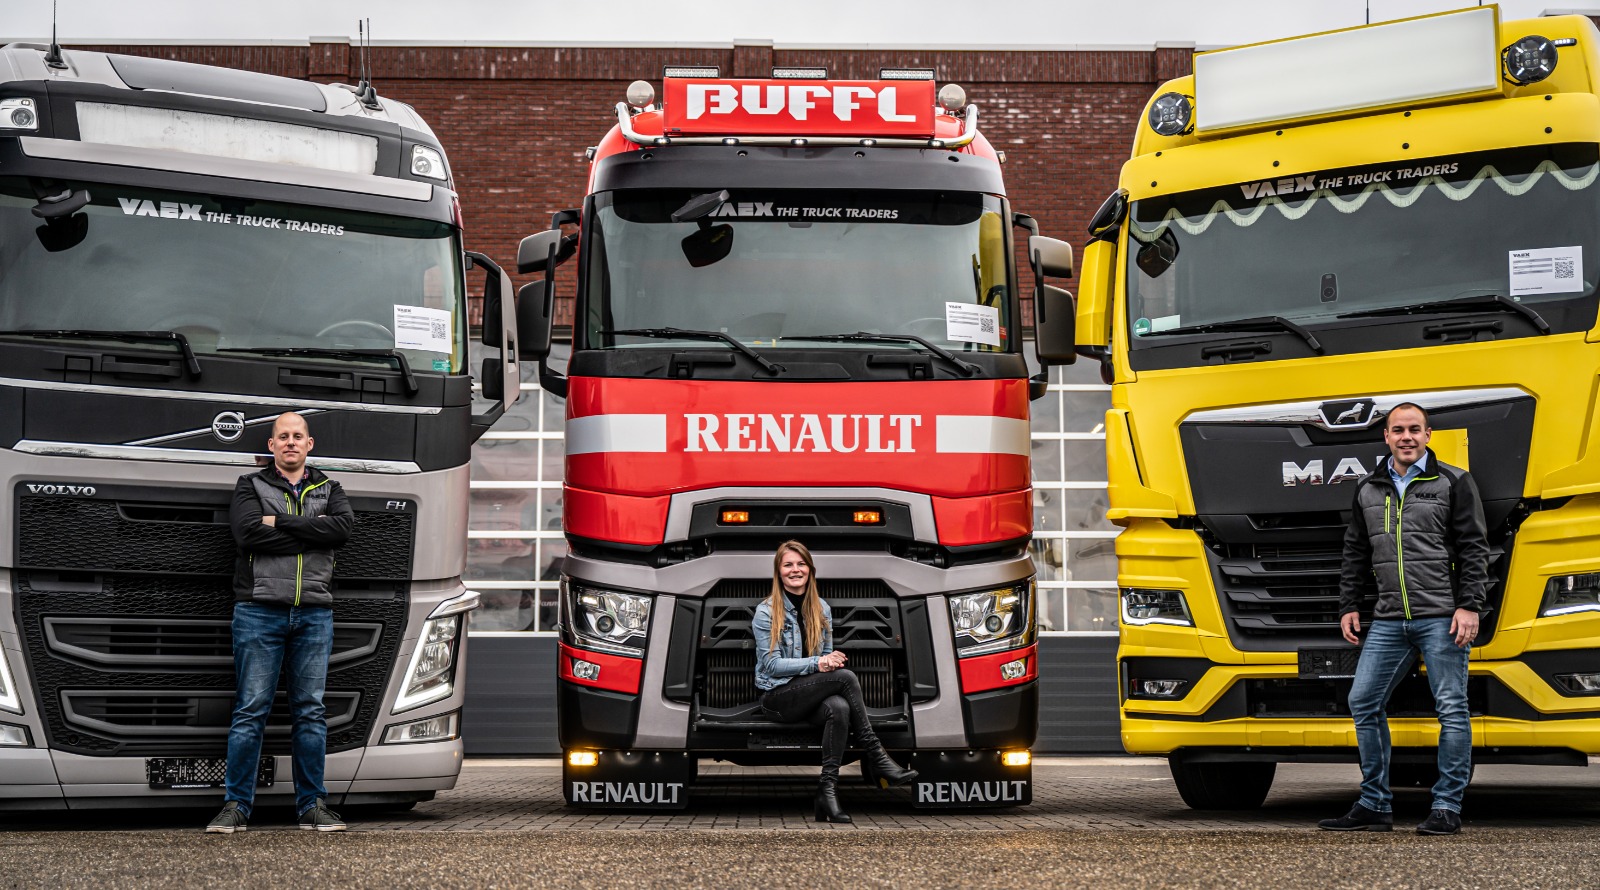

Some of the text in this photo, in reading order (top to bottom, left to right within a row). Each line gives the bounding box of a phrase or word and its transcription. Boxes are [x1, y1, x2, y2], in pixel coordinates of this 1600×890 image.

[687, 84, 917, 122] BUFFL
[1240, 162, 1459, 200] VAEX THE TRUCK TRADERS
[117, 197, 345, 236] VAEX THE TRUCK TRADERS
[776, 207, 799, 217] THE
[802, 207, 842, 218] TRUCK
[845, 208, 899, 219] TRADERS
[683, 413, 922, 453] RENAULT
[1282, 456, 1385, 487] MA
[26, 484, 97, 496] VOLVO
[385, 500, 407, 511] FH
[572, 781, 684, 803] RENAULT
[918, 780, 1027, 802] RENAULT
